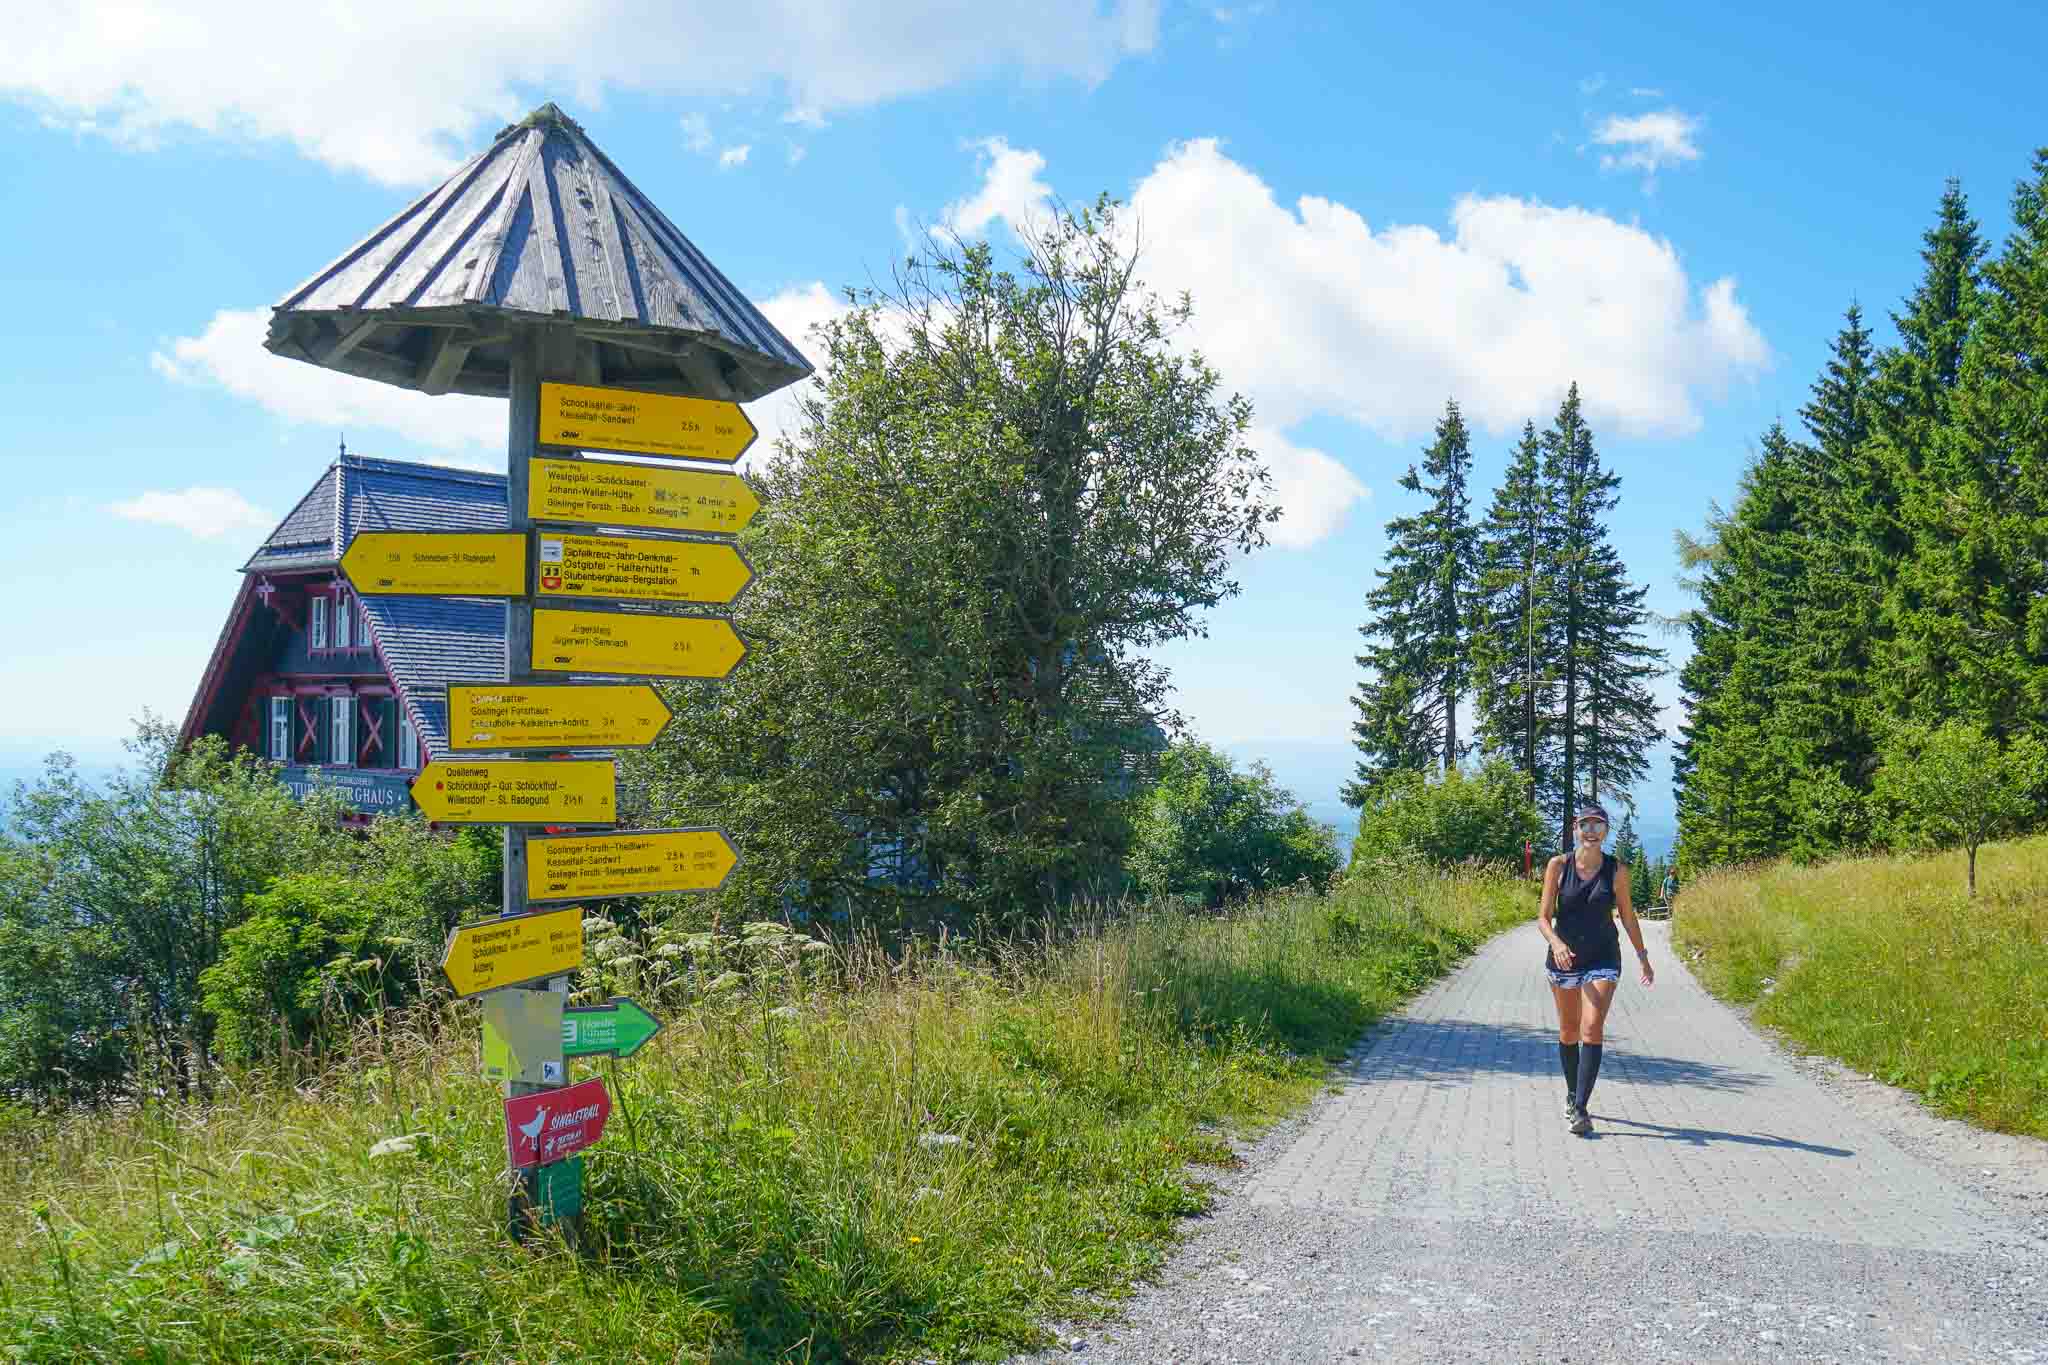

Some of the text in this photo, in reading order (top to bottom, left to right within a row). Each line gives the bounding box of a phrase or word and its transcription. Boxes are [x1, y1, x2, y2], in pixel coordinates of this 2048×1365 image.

[622, 504, 640, 513] Buch
[564, 560, 605, 571] Ostgipfel
[446, 767, 489, 778] Quellenweg
[287, 782, 393, 805] STUBERGHAUS
[511, 794, 549, 806] Radegund
[551, 1104, 600, 1129] SINGLETRAIL
